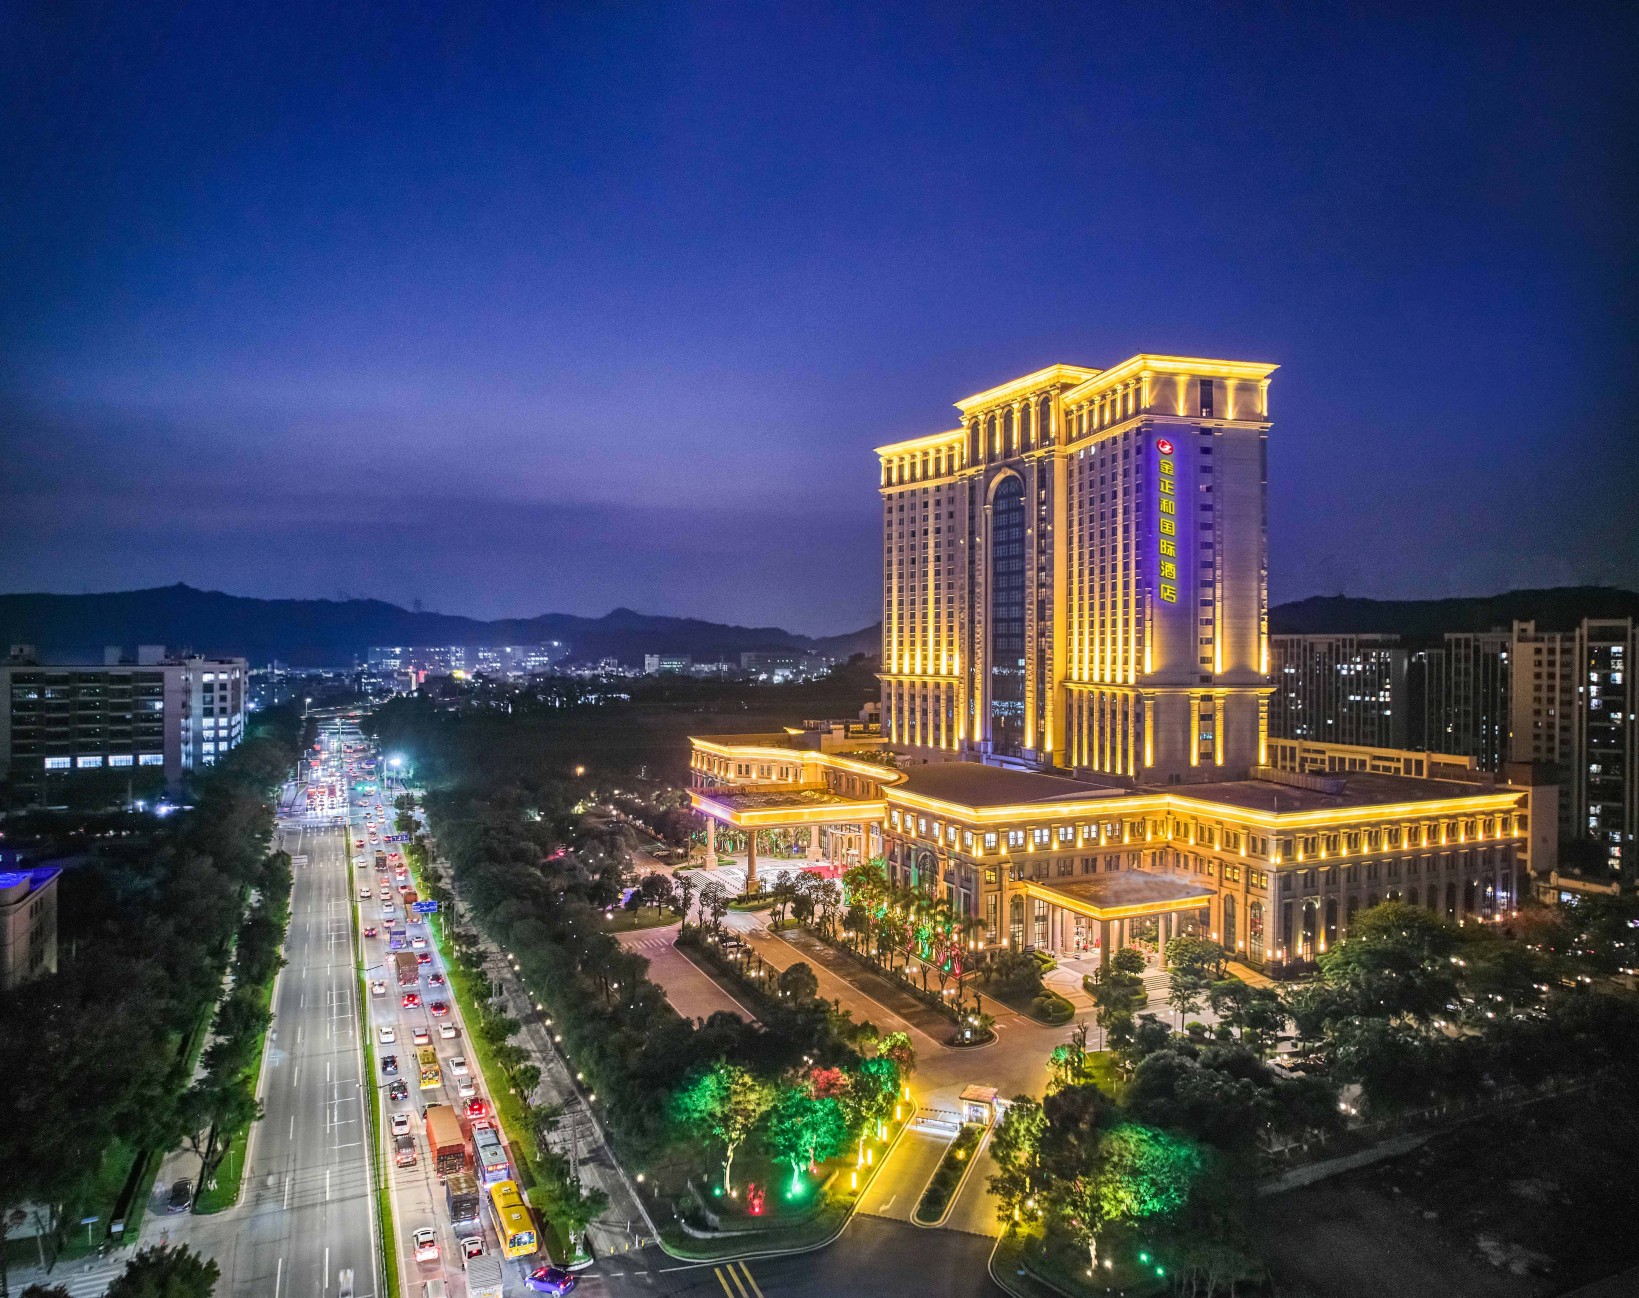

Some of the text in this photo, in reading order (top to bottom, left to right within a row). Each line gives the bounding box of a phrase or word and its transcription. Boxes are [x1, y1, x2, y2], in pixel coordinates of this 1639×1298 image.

[1159, 459, 1176, 603] 金正和国际酒店
